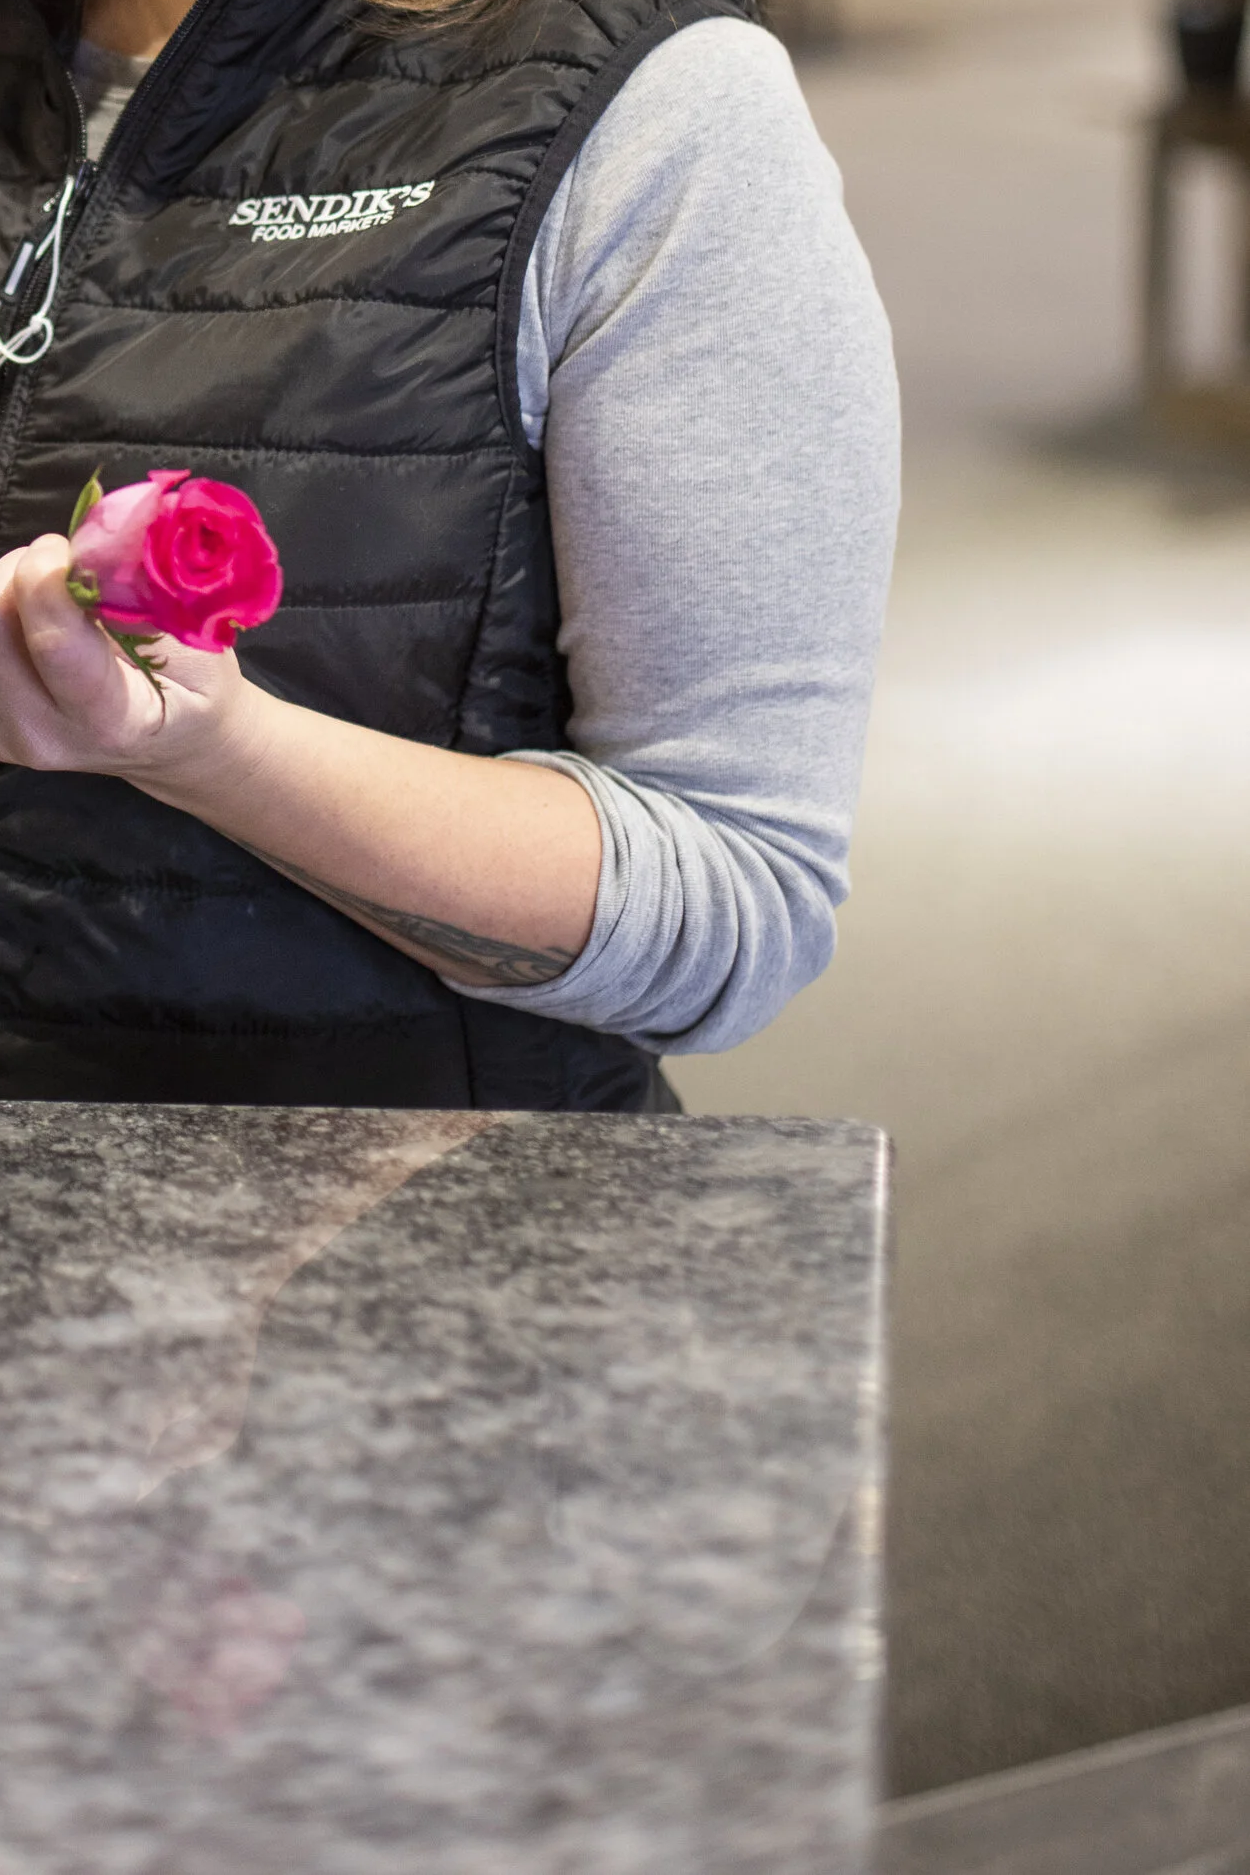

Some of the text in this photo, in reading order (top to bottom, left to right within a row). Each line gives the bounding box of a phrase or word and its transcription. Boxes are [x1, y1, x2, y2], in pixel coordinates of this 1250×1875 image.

[229, 180, 435, 226] SENDIK'S
[252, 210, 394, 243] FOOD MARKETS
